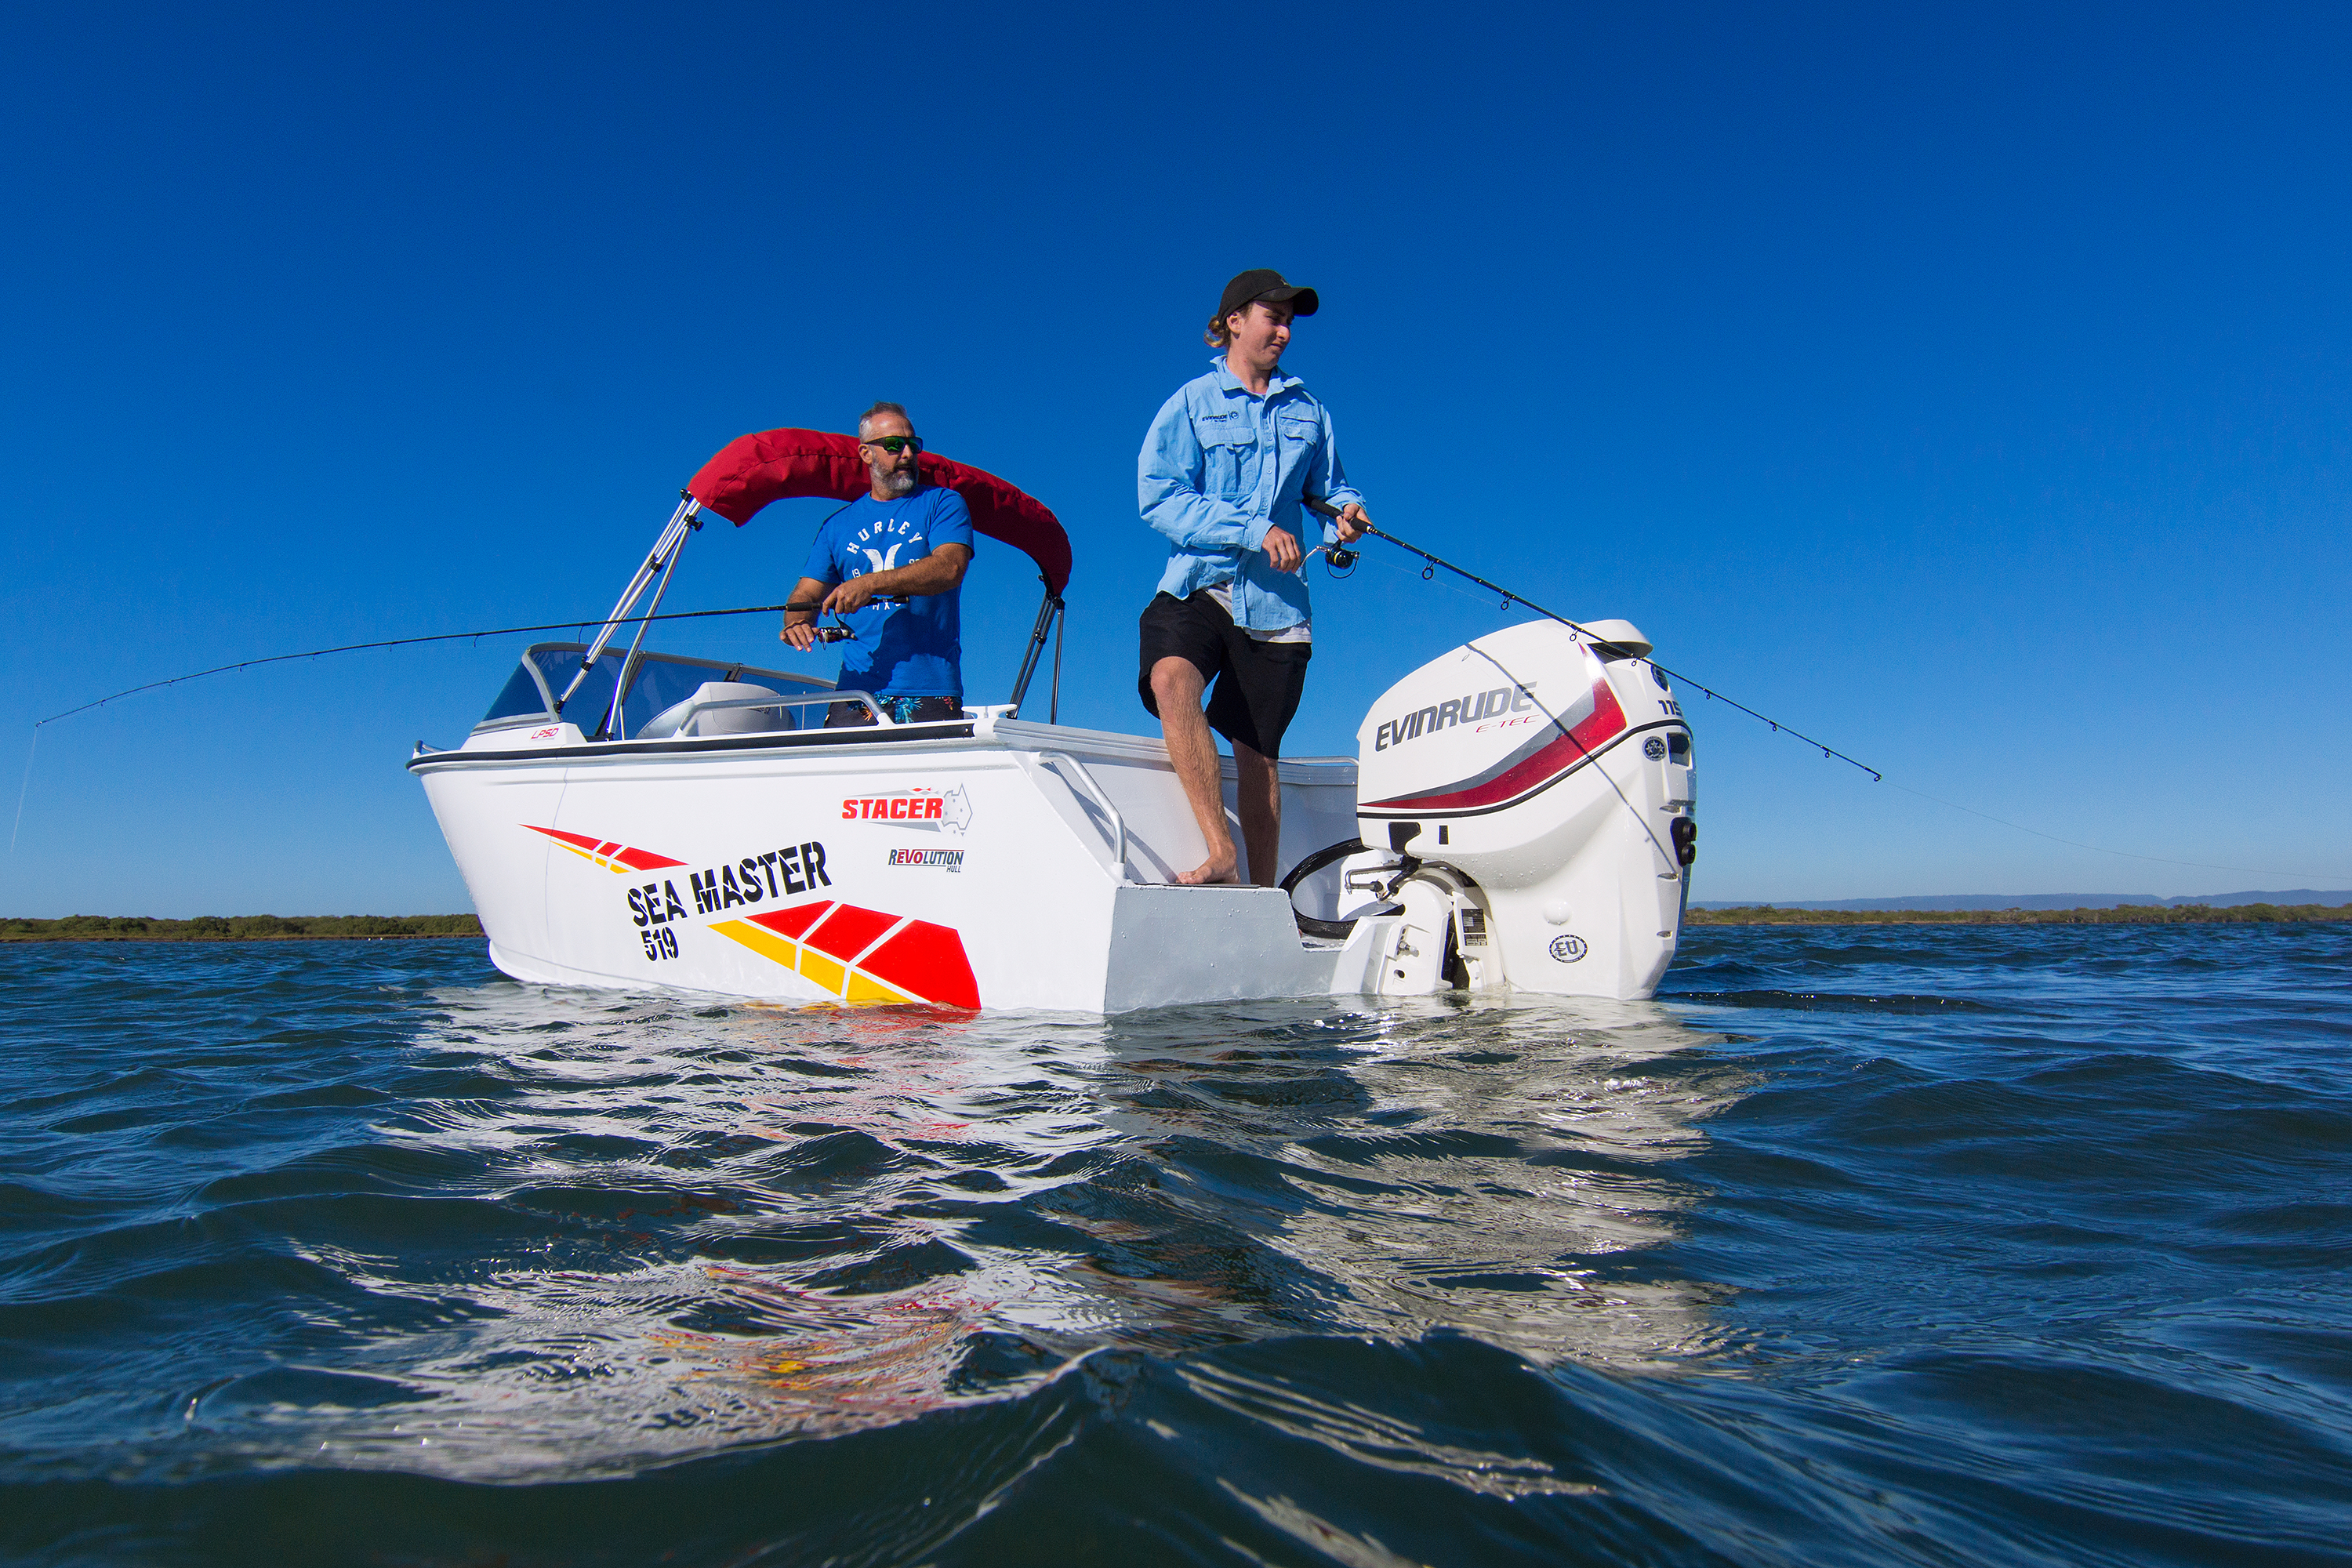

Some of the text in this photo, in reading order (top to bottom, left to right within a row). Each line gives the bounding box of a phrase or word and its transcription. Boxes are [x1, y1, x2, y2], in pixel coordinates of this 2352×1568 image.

[846, 518, 923, 554] HURLEY
[1375, 681, 1538, 753] EVINRUDE
[1657, 699, 1682, 717] 115
[1475, 714, 1541, 733] E-TEC
[841, 798, 943, 819] STACER
[888, 849, 964, 865] REVOLUTION
[627, 841, 832, 927] SEA MASTER
[641, 927, 679, 961] 519
